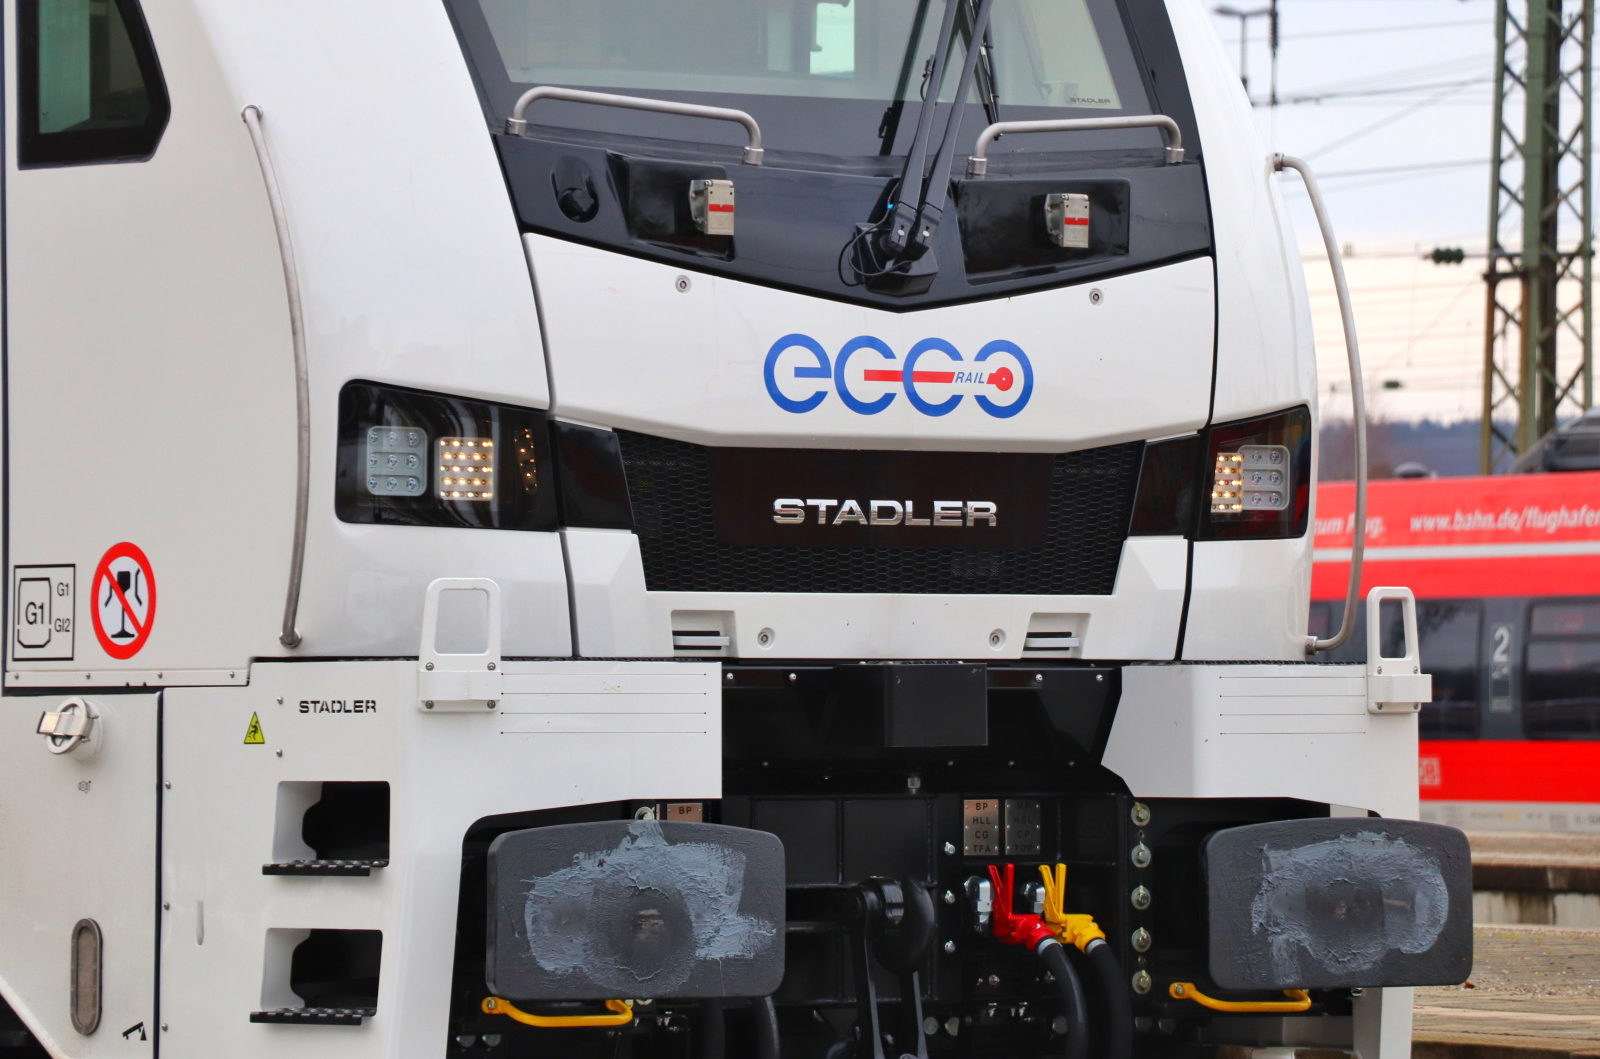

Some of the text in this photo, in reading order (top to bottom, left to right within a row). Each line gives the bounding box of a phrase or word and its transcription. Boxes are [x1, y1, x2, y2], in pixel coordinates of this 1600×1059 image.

[955, 371, 985, 384] RAIL
[773, 498, 998, 527] STADLER
[56, 582, 69, 597] G1
[25, 601, 44, 626] G1
[1493, 626, 1510, 662] 2
[298, 699, 377, 714] STADLER
[678, 806, 692, 815] BP
[975, 802, 989, 811] BP
[972, 816, 992, 825] HLL
[974, 830, 989, 839] CG
[973, 844, 992, 853] TFA
